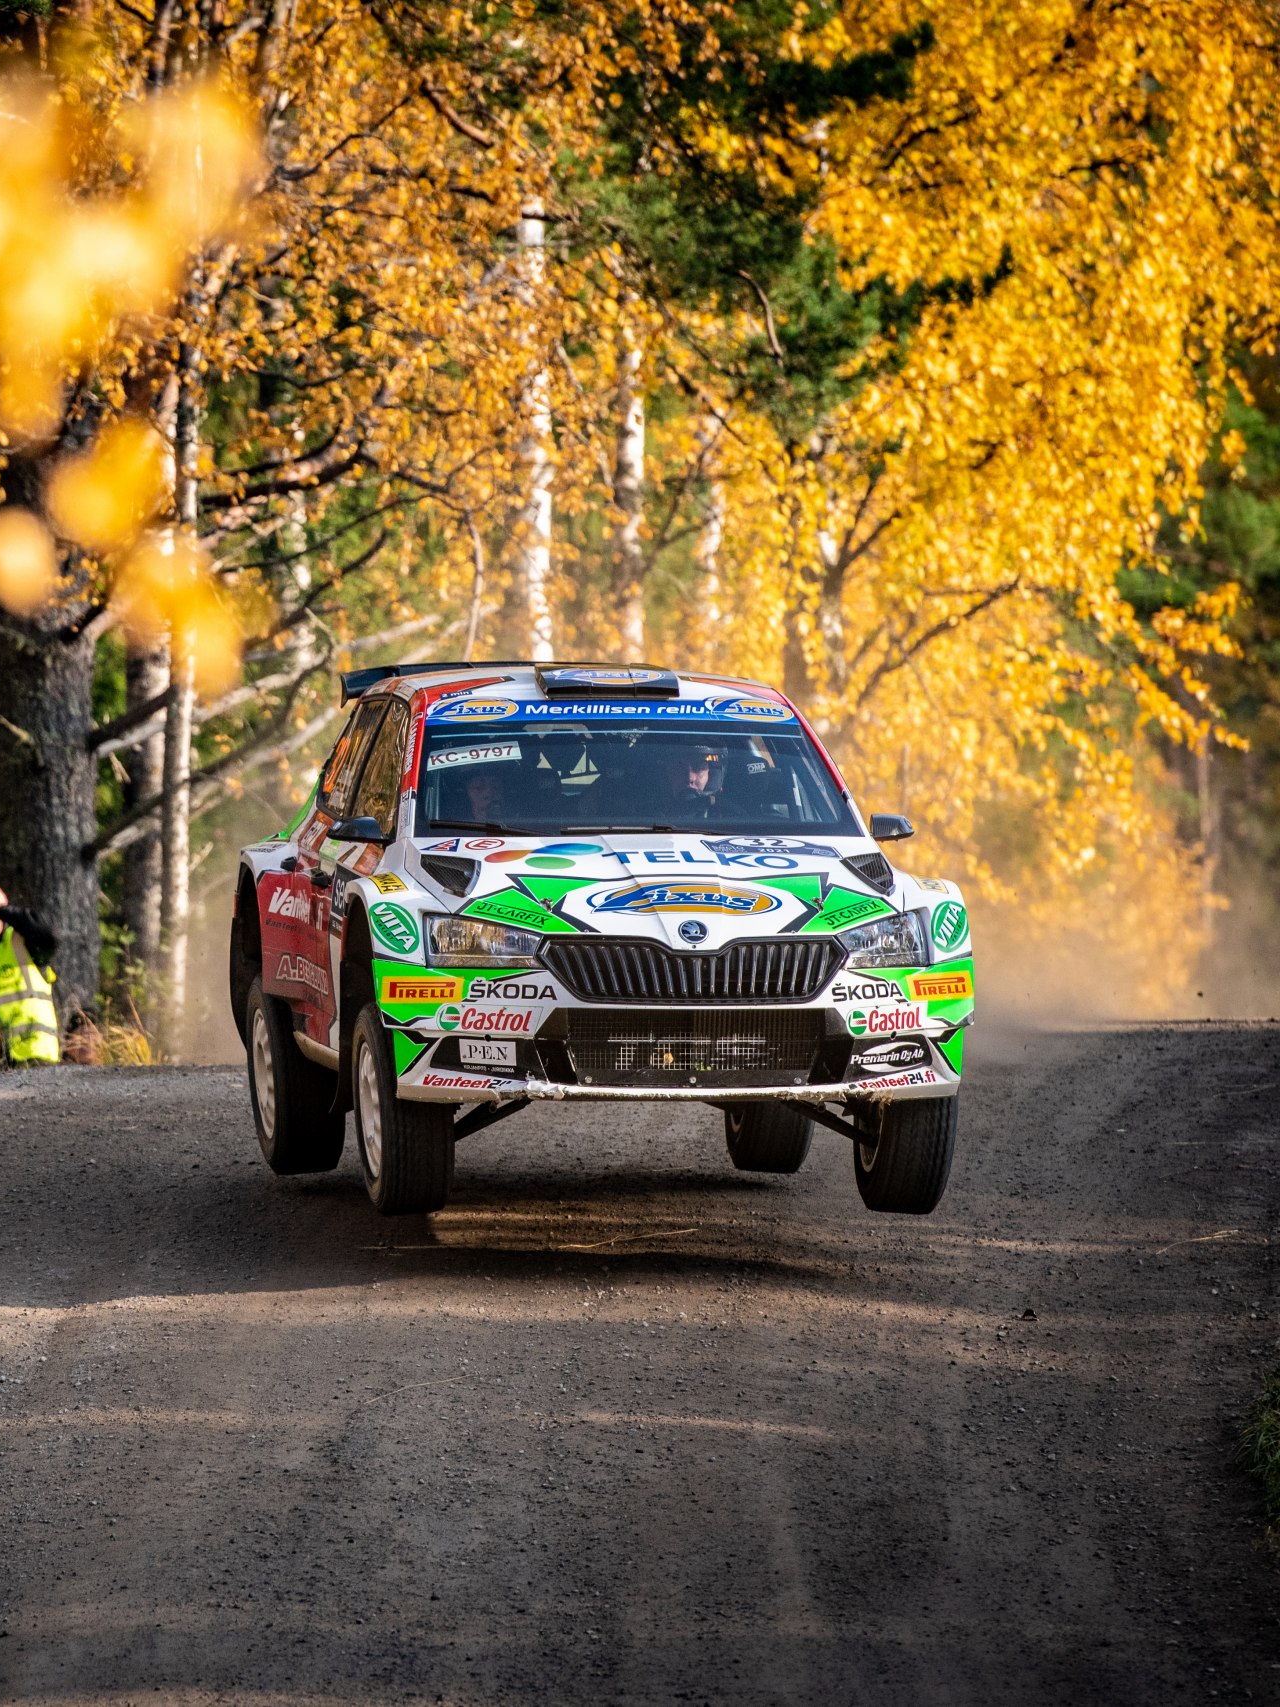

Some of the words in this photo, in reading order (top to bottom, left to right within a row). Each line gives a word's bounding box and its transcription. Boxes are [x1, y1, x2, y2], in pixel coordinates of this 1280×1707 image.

[428, 698, 509, 718] Fixus
[525, 704, 651, 715] Merkillisen
[711, 698, 785, 718] Fixus
[430, 745, 514, 766] KC-9797
[744, 838, 787, 847] 32
[602, 850, 799, 869] TELKO
[591, 882, 757, 914] Fixus
[373, 903, 416, 952] VIITA
[934, 903, 963, 948] VIITA
[389, 982, 457, 998] PIRELLI
[470, 979, 558, 1001] ŠKODA
[831, 983, 903, 1003] ŠKODA
[913, 976, 966, 996] PIRELLI
[461, 1008, 533, 1032] Castrol
[868, 1007, 922, 1032] Castrol
[850, 1052, 900, 1065] Premarin
[911, 1048, 924, 1059] Ab
